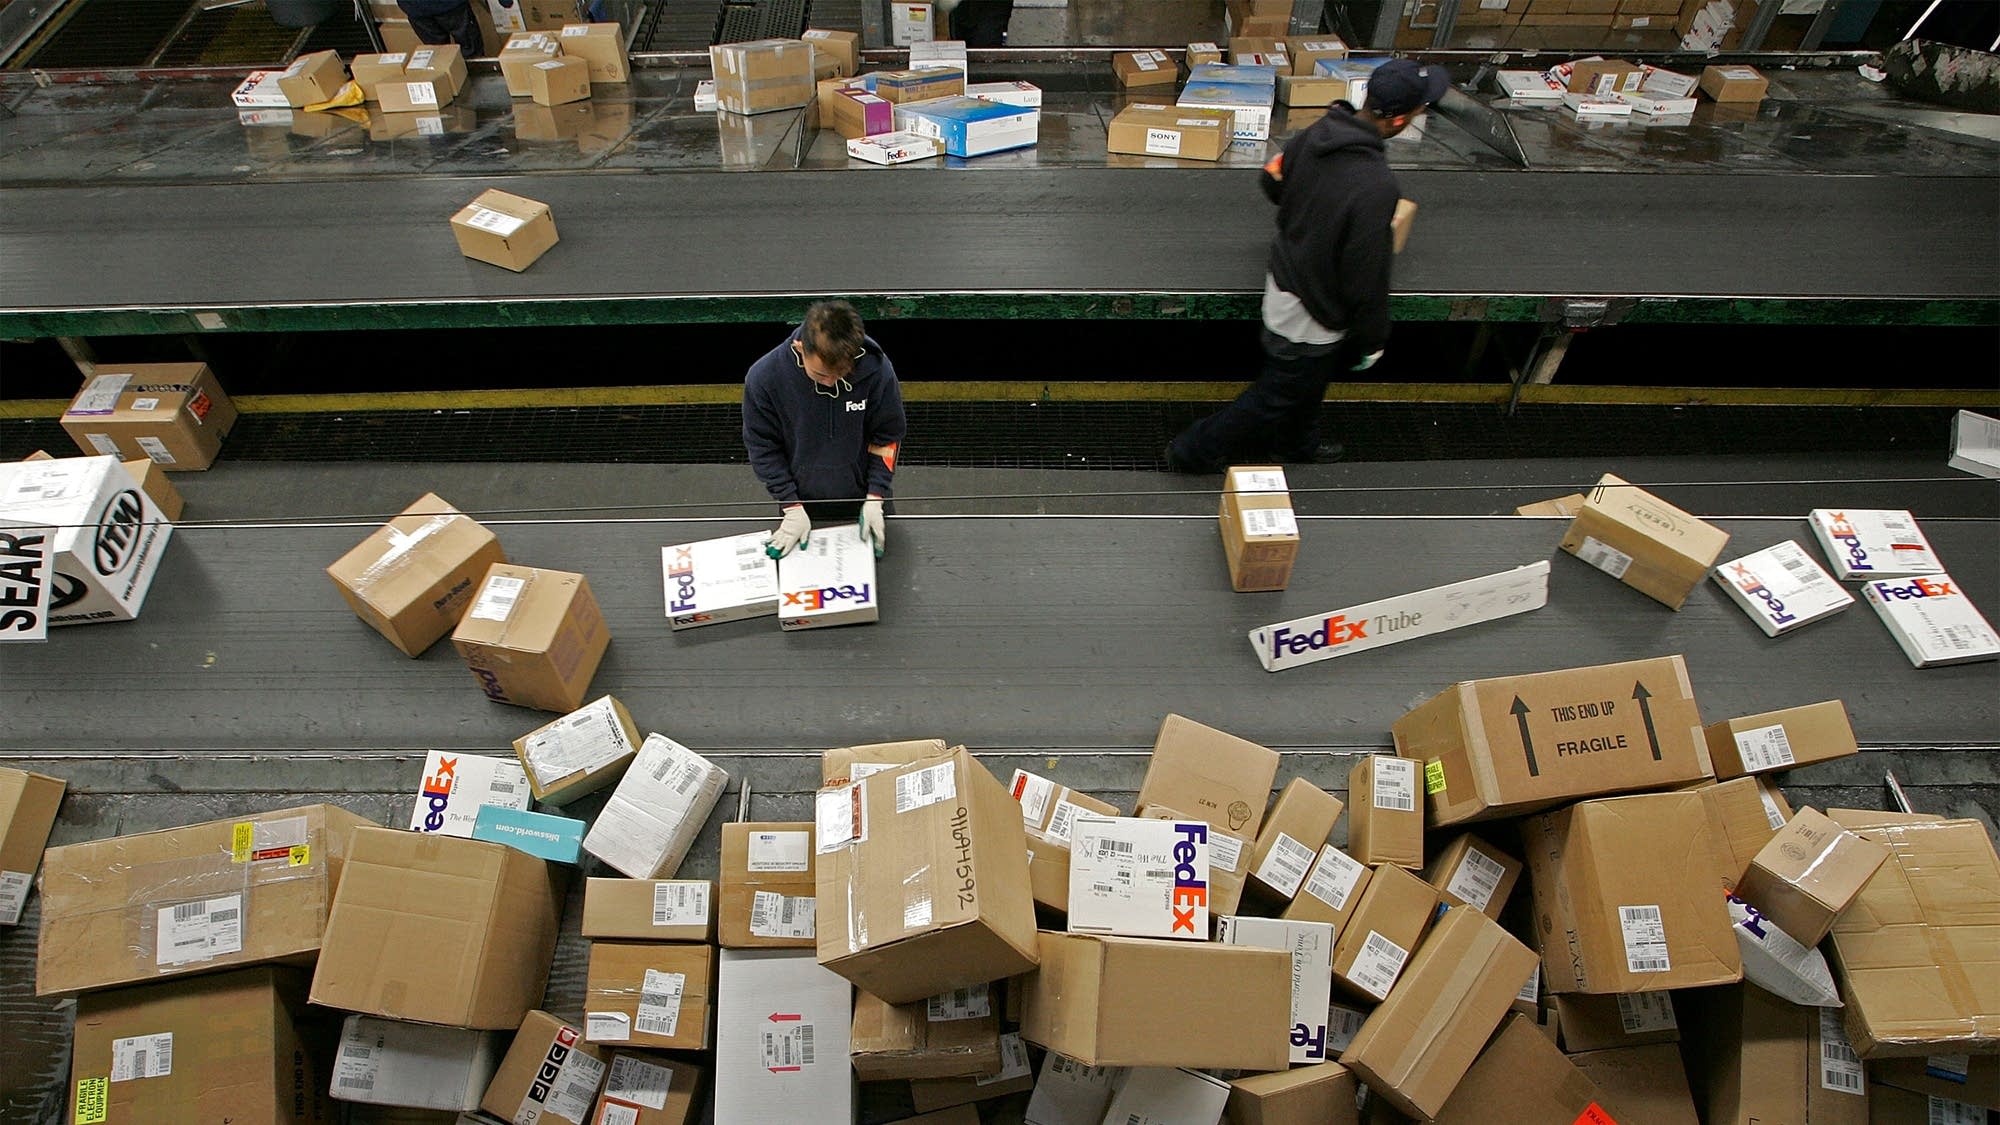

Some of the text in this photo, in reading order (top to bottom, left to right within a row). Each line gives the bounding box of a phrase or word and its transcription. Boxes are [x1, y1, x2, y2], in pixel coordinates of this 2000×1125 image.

[1151, 132, 1177, 141] SONY
[887, 149, 908, 160] FedEx
[98, 498, 140, 568] JTM
[1626, 504, 1685, 536] LIBERTY
[1828, 511, 1873, 570] FedEx
[669, 545, 696, 613] FedEx
[1729, 562, 1796, 625] FedEx
[1874, 578, 1957, 602] FedEx
[783, 584, 869, 611] FedEx
[674, 612, 712, 625] FedEx
[1274, 611, 1422, 659] FedEx Tube
[1551, 701, 1616, 723] THIS END UP
[1556, 735, 1628, 757] FRAGILE
[415, 756, 458, 832] edEx
[450, 813, 476, 822] The Wor
[495, 823, 560, 842] blissworld.com
[951, 806, 975, 911] 91694592
[1172, 824, 1207, 934] FedEx
[1295, 933, 1305, 955] Time
[1566, 928, 1586, 989] PLACE
[1294, 957, 1303, 973] On
[78, 1080, 88, 1114] FRAGILE
[86, 1079, 97, 1121] ELECTRON
